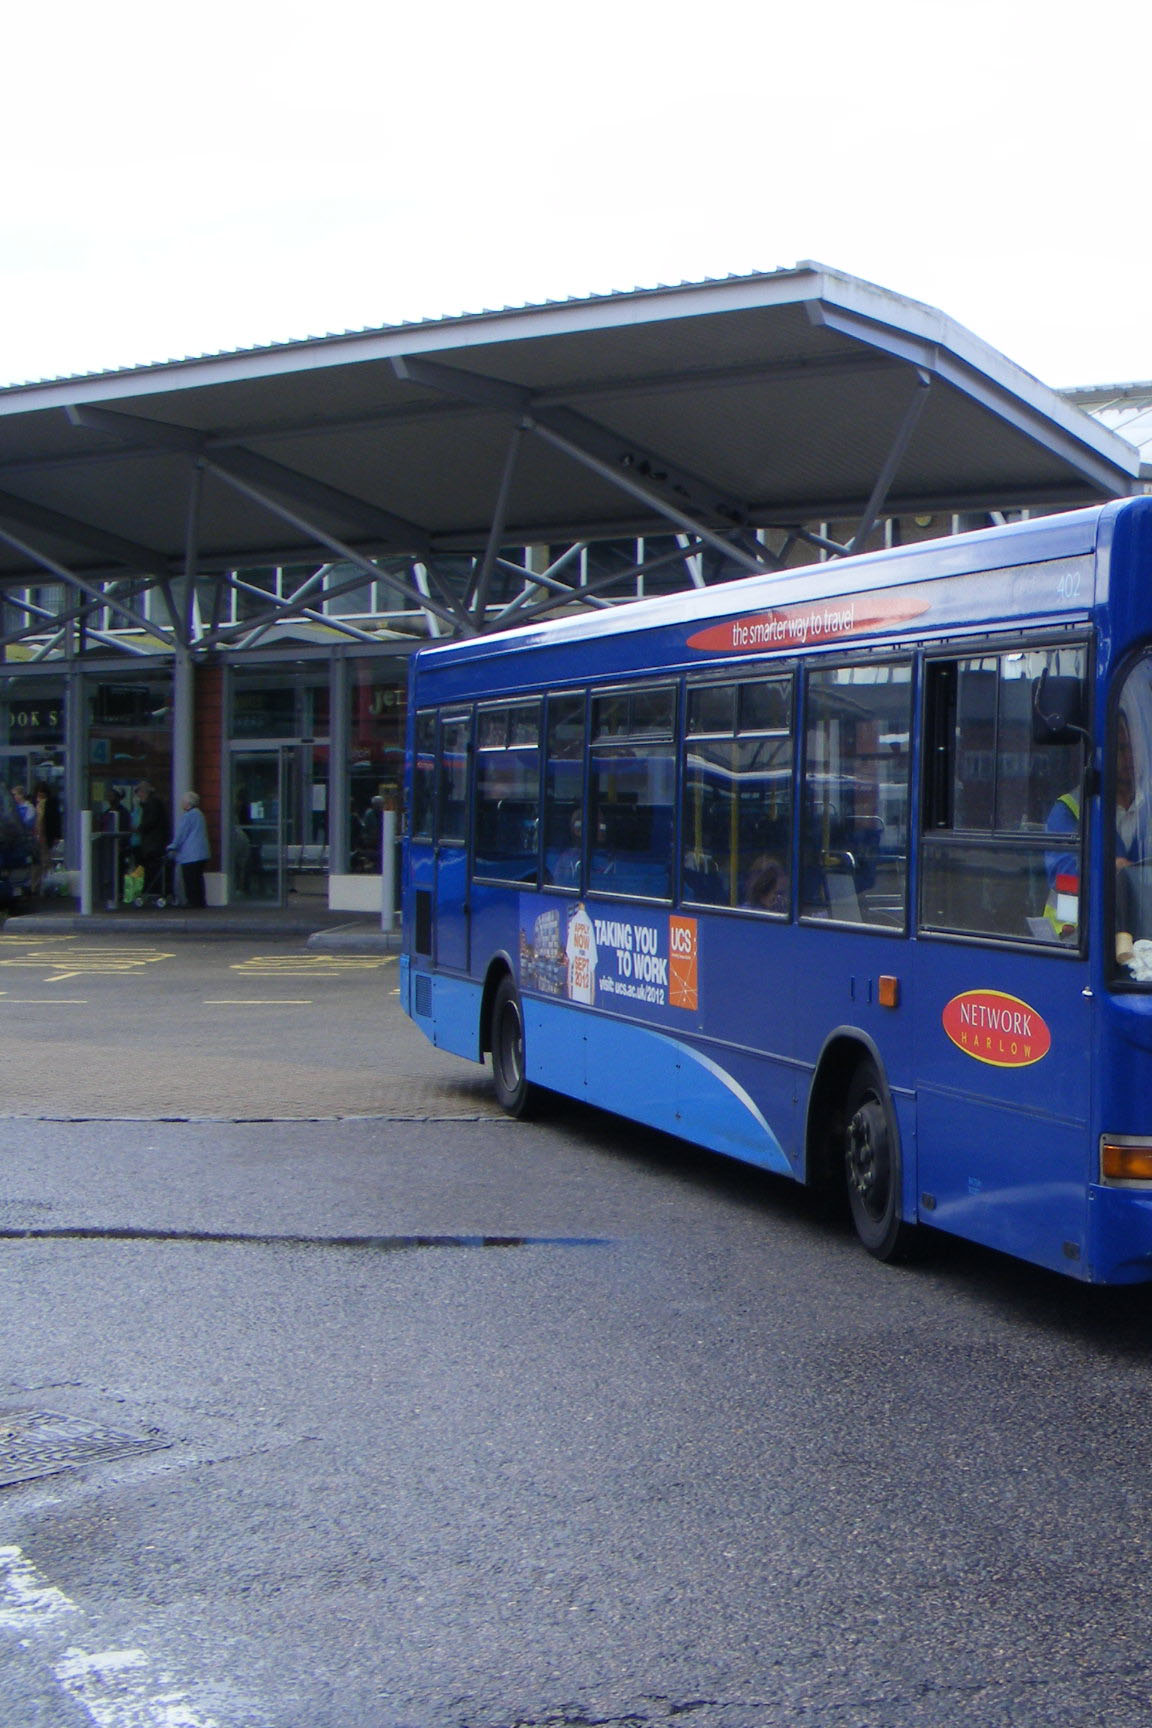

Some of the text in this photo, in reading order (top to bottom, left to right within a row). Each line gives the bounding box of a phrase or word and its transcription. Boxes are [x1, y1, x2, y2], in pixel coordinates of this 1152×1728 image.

[1056, 571, 1081, 598] 402
[732, 602, 855, 647] the smarter way to travel
[573, 935, 590, 951] NOW
[595, 920, 657, 955] TAKING YOU
[671, 928, 691, 952] UCS
[616, 949, 668, 985] TO WORK
[960, 1002, 1032, 1037] NETWORK
[960, 1032, 1032, 1058] HARLOW
